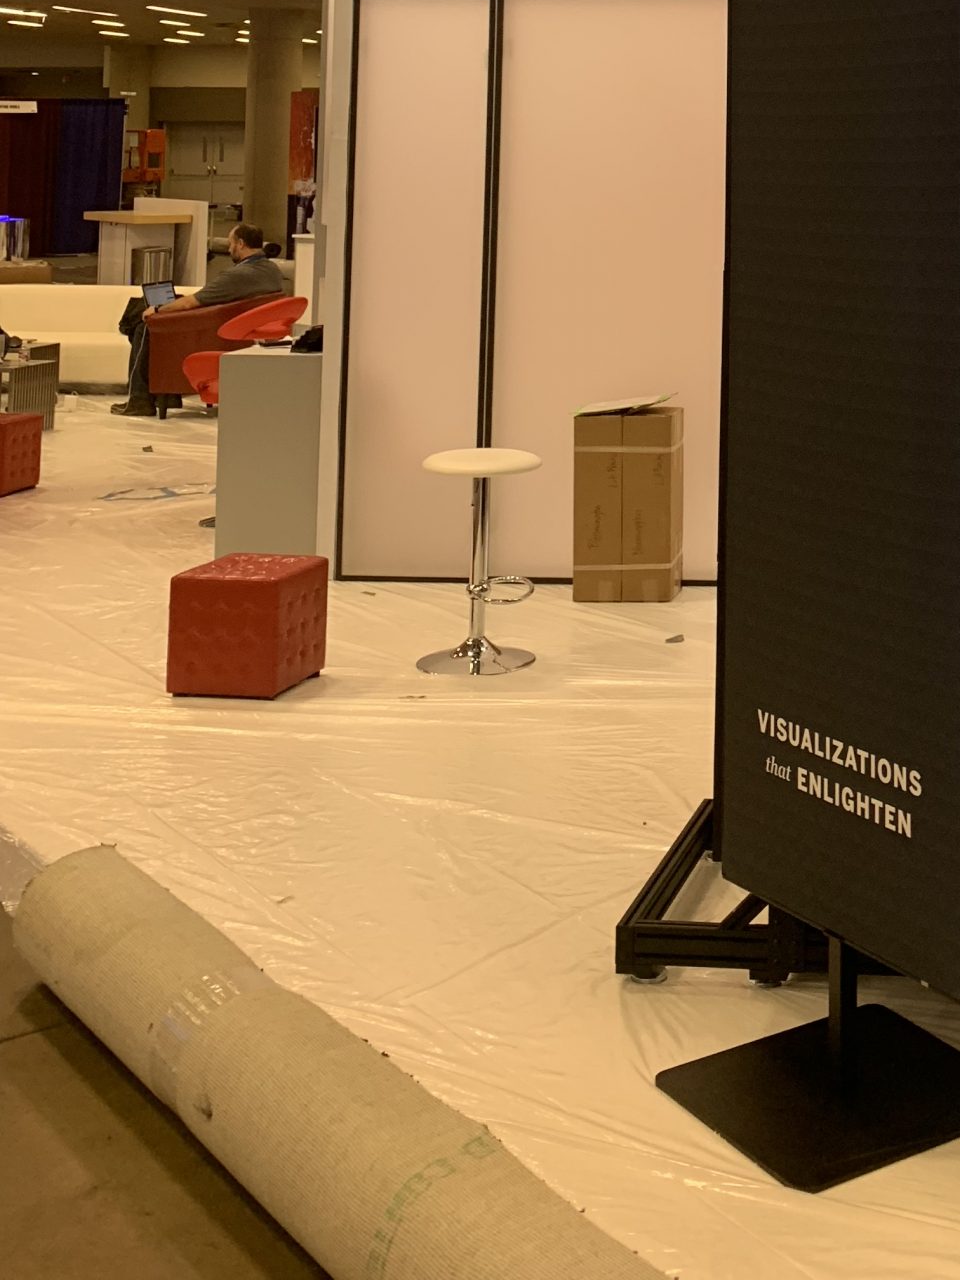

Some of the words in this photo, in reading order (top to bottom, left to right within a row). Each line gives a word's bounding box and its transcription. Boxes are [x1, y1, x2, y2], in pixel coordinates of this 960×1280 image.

[757, 708, 922, 797] VISUALIZATIONS
[765, 755, 791, 782] that
[797, 767, 912, 838] ENLIGHTEN
